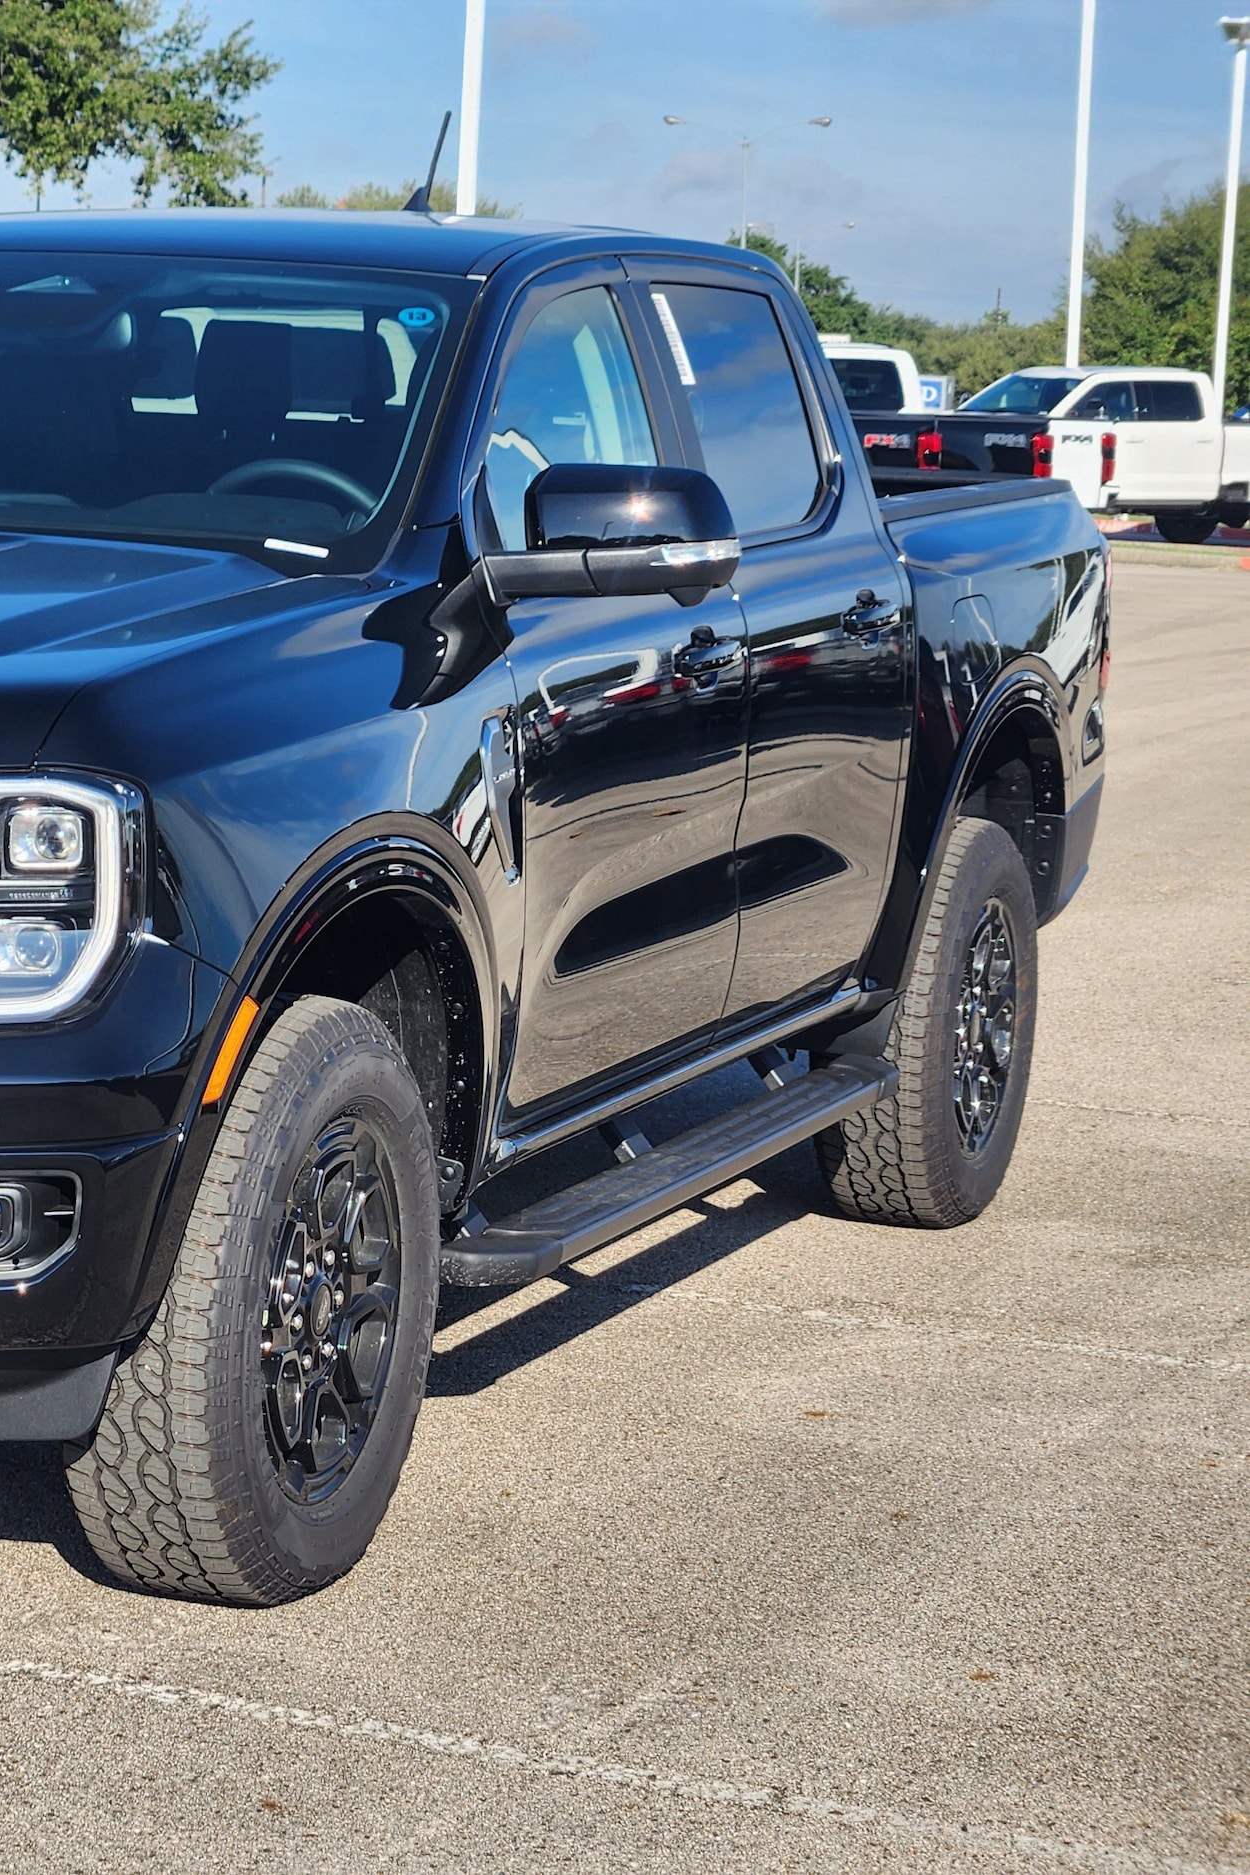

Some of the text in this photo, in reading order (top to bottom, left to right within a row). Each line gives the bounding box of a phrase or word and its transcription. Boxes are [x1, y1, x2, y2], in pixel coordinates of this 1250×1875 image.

[864, 433, 911, 449] FX4
[984, 433, 1026, 448] FX4
[1061, 434, 1093, 444] FX4
